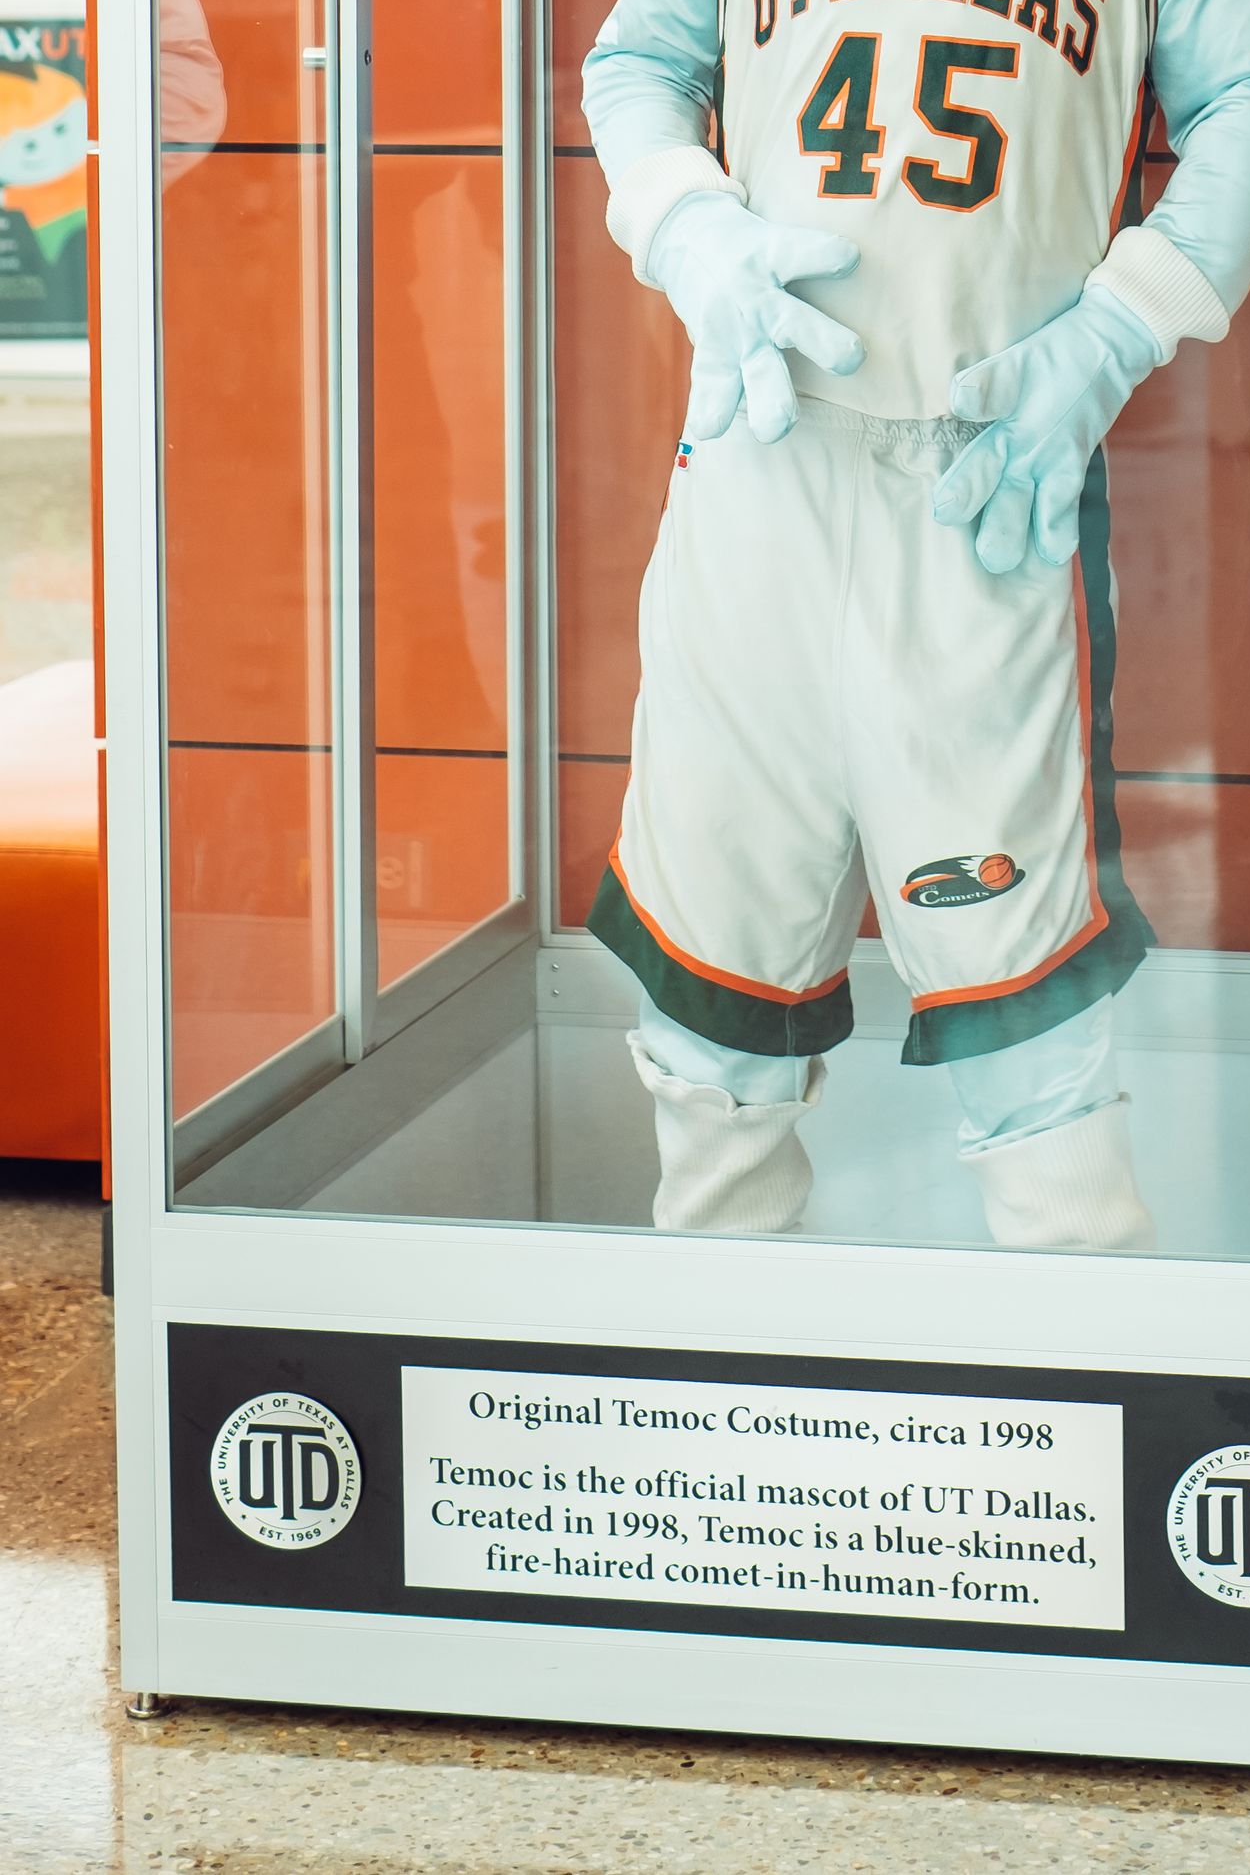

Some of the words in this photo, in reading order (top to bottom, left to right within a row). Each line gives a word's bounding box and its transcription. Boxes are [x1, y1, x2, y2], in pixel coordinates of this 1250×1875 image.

[797, 31, 1020, 213] 45
[919, 890, 990, 905] Comets
[272, 1398, 289, 1407] OF
[297, 1401, 335, 1430] TEXAS
[470, 1392, 602, 1430] Original
[612, 1400, 716, 1431] Temoc
[728, 1407, 878, 1444] Costume,
[890, 1416, 966, 1445] circa
[981, 1422, 1053, 1449] 1998
[218, 1402, 264, 1469] UNIVERSITY
[336, 1436, 349, 1450] AT
[239, 1423, 340, 1520] UTD
[1232, 1451, 1250, 1461] OF
[219, 1478, 233, 1504] THE
[340, 1460, 355, 1509] DALLAS
[430, 1458, 532, 1489] Temoc
[544, 1465, 566, 1491] is
[577, 1466, 624, 1494] the
[636, 1470, 745, 1501] official
[758, 1486, 869, 1509] mascot
[881, 1484, 914, 1511] of
[923, 1487, 973, 1514] UT
[985, 1490, 1095, 1522] Dallas.
[1174, 1455, 1223, 1525] UNIVERSITY
[259, 1526, 286, 1541] EST.
[291, 1528, 322, 1542] 1969
[432, 1500, 553, 1531] Created
[565, 1508, 593, 1534] in
[608, 1512, 687, 1544] 1998,
[699, 1516, 803, 1547] Temoc
[815, 1523, 837, 1549] is
[849, 1533, 864, 1550] a
[875, 1525, 1096, 1569] blue-skinned,
[1175, 1534, 1191, 1562] THE
[487, 1544, 654, 1579] fire-haired
[665, 1554, 1038, 1604] comet-in-human-form.
[1217, 1584, 1246, 1600] EST.
